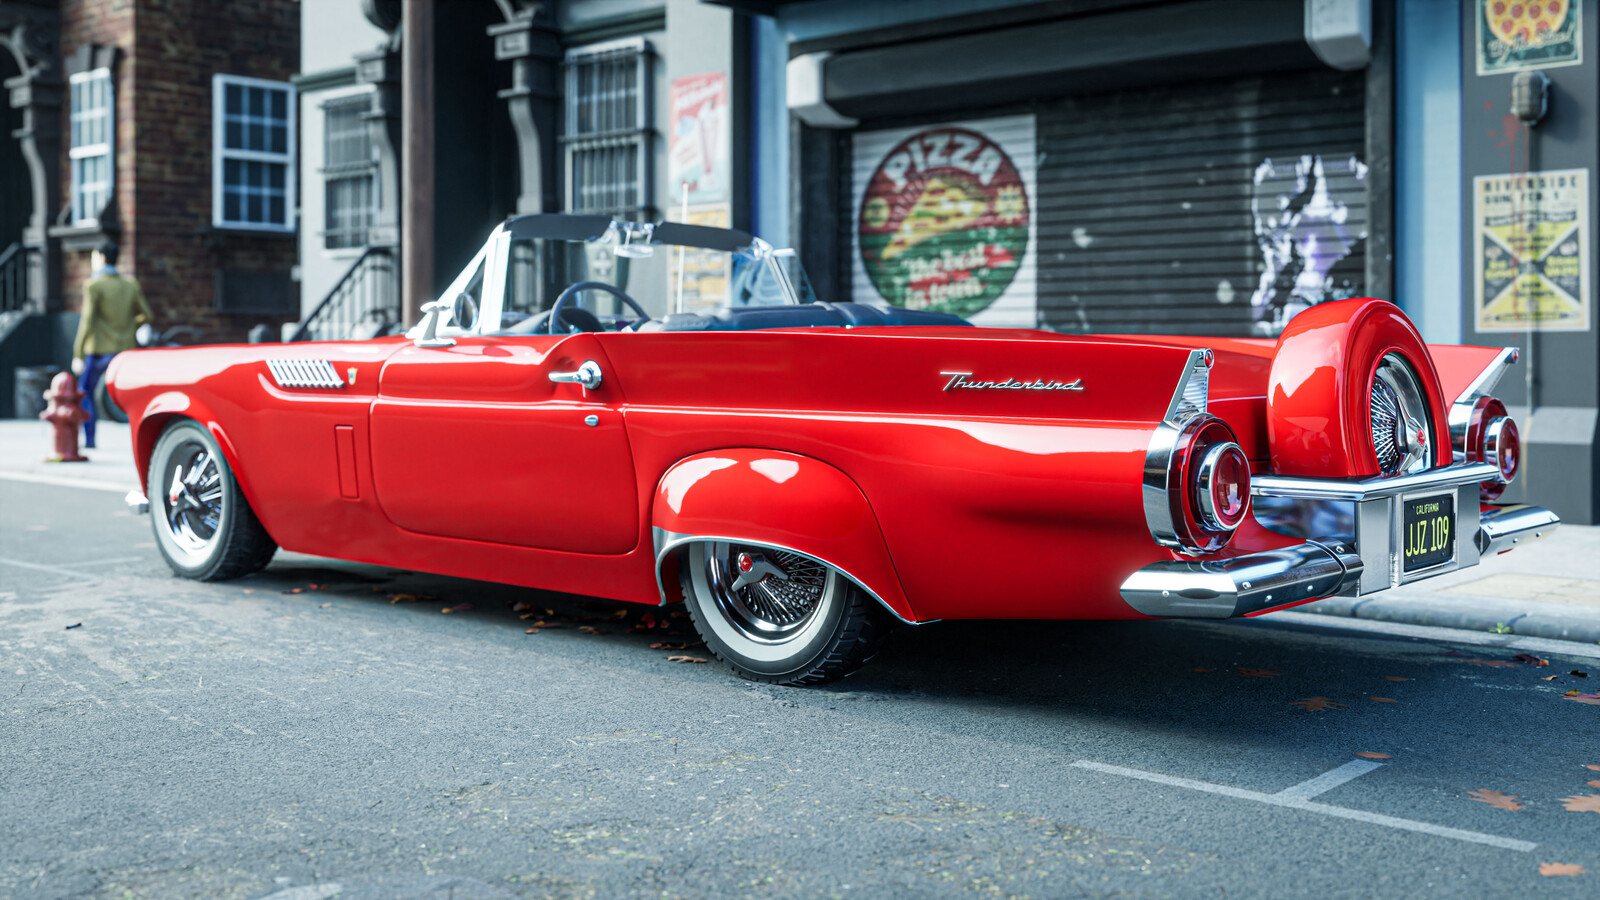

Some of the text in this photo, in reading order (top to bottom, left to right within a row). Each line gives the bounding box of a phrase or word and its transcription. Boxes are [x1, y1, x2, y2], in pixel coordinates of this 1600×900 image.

[883, 133, 1002, 192] PIZZA
[1484, 176, 1576, 192] RIVERSIDE
[940, 371, 1084, 391] Thunderbird
[1416, 502, 1439, 515] CALIFORNIA
[1405, 515, 1449, 557] JJZ 109
